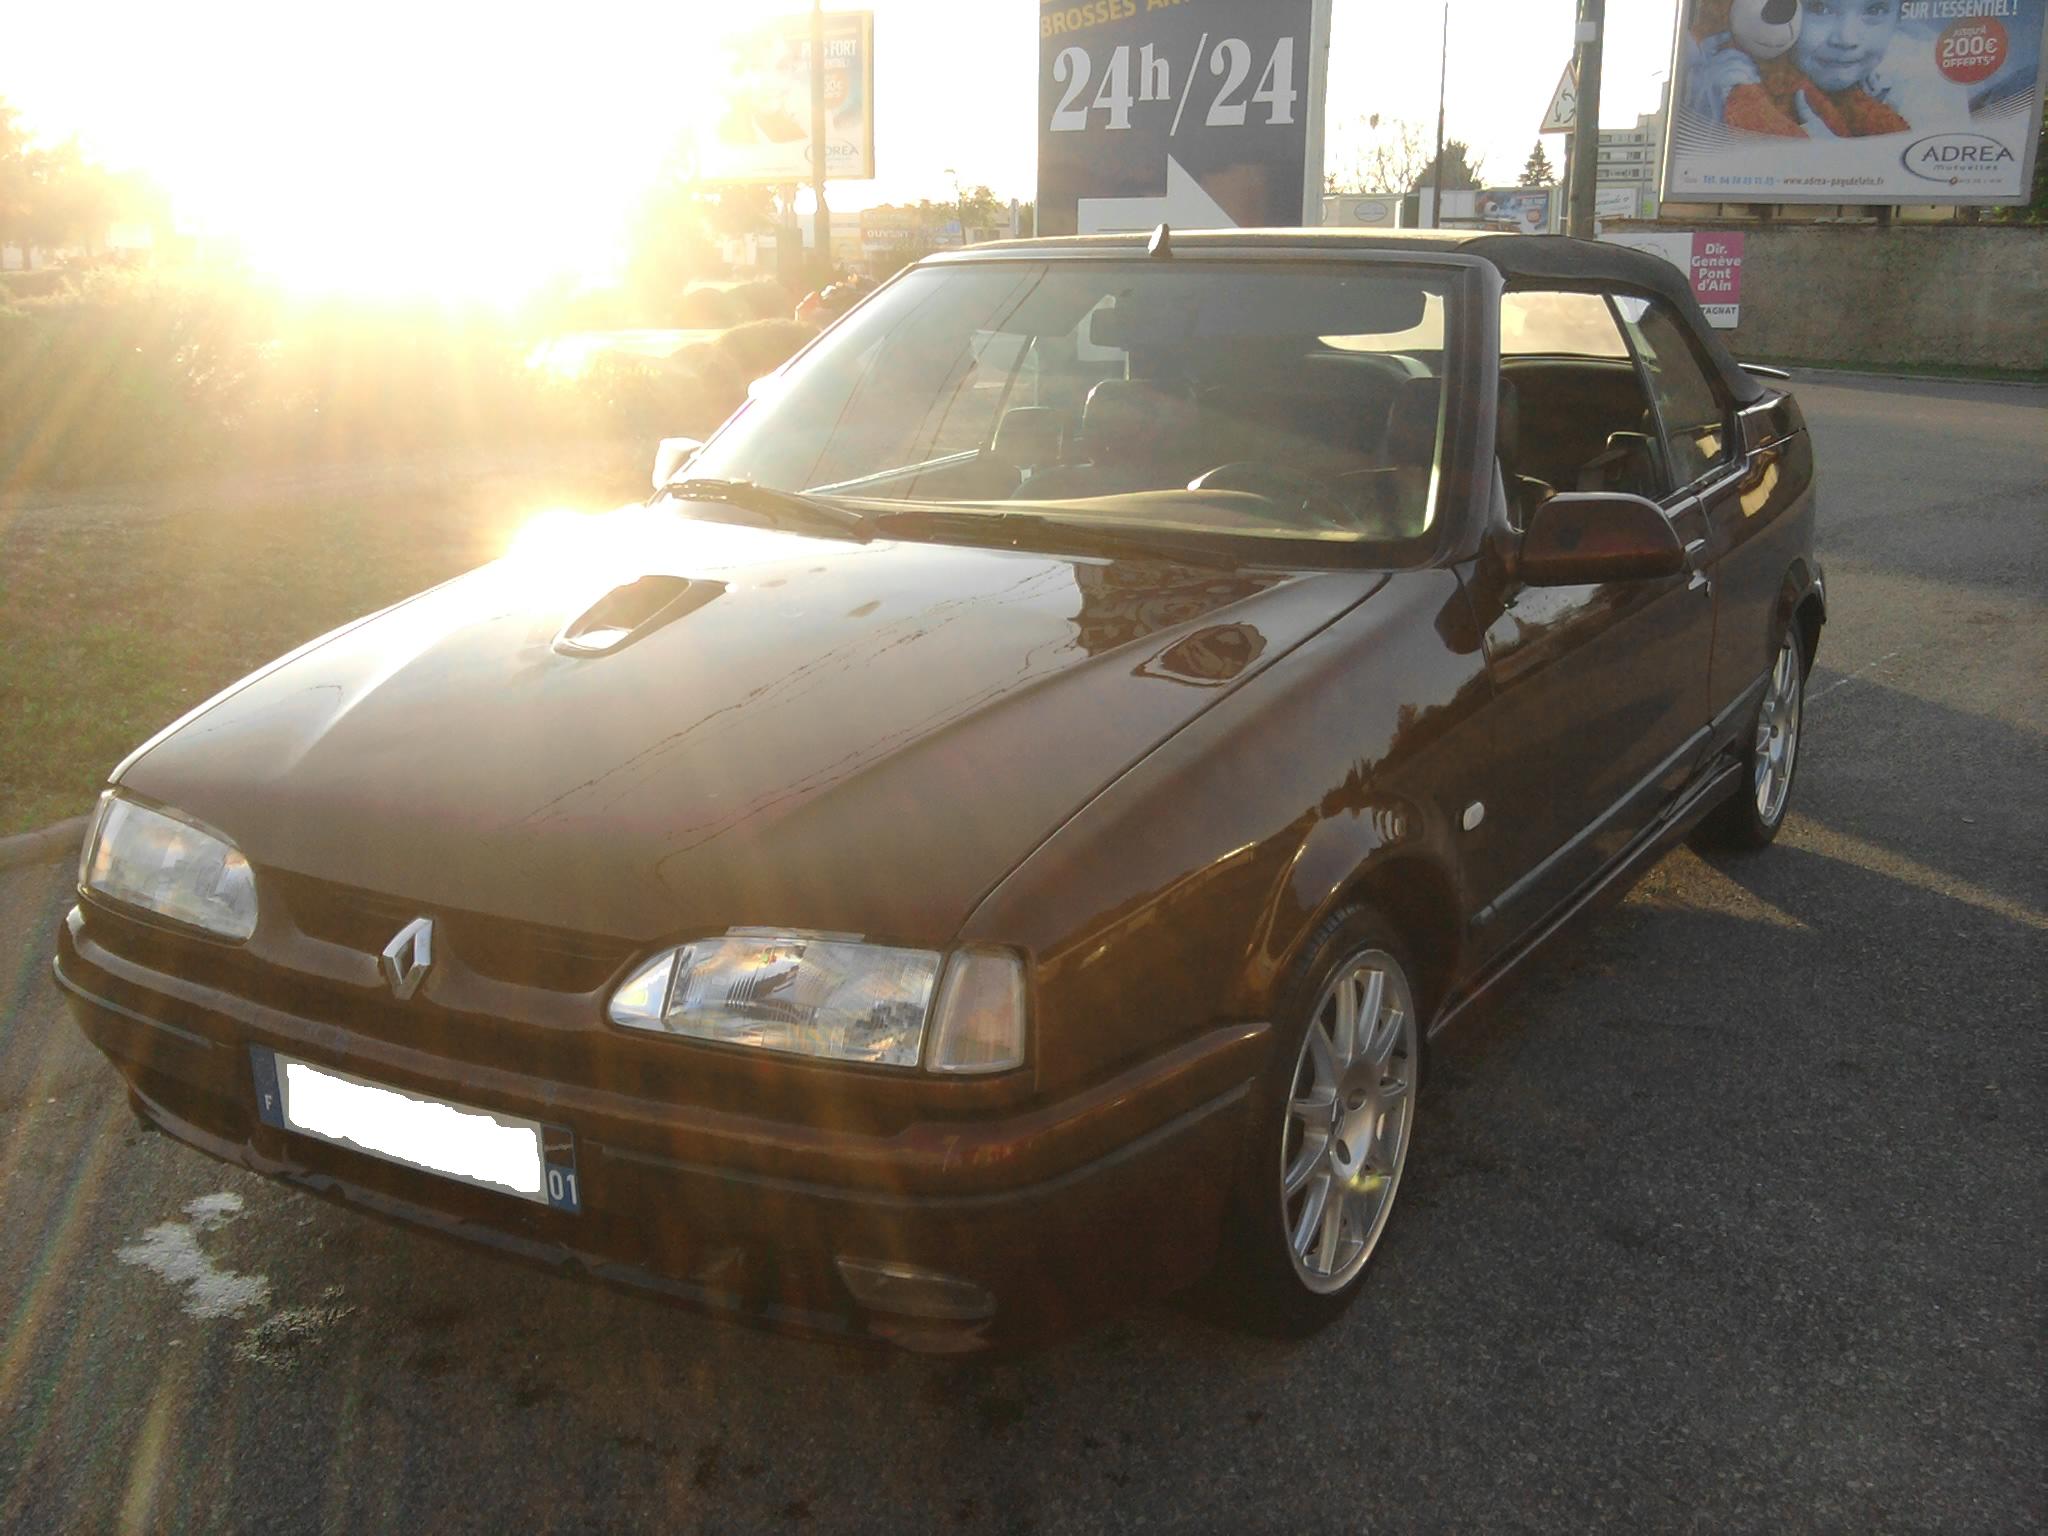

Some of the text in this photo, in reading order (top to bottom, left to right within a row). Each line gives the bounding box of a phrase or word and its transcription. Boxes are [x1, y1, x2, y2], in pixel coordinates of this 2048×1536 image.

[1040, 0, 1137, 38] BROSSES
[1901, 2, 1929, 19] SUR
[831, 39, 857, 56] FORT
[1942, 37, 1998, 58] 200€
[1921, 145, 2015, 162] ADREA
[1705, 243, 1728, 254] Dir.
[1691, 255, 1742, 267] Genève
[1699, 268, 1731, 279] Pont
[1697, 279, 1732, 291] d'Ain
[549, 1169, 579, 1206] 01
